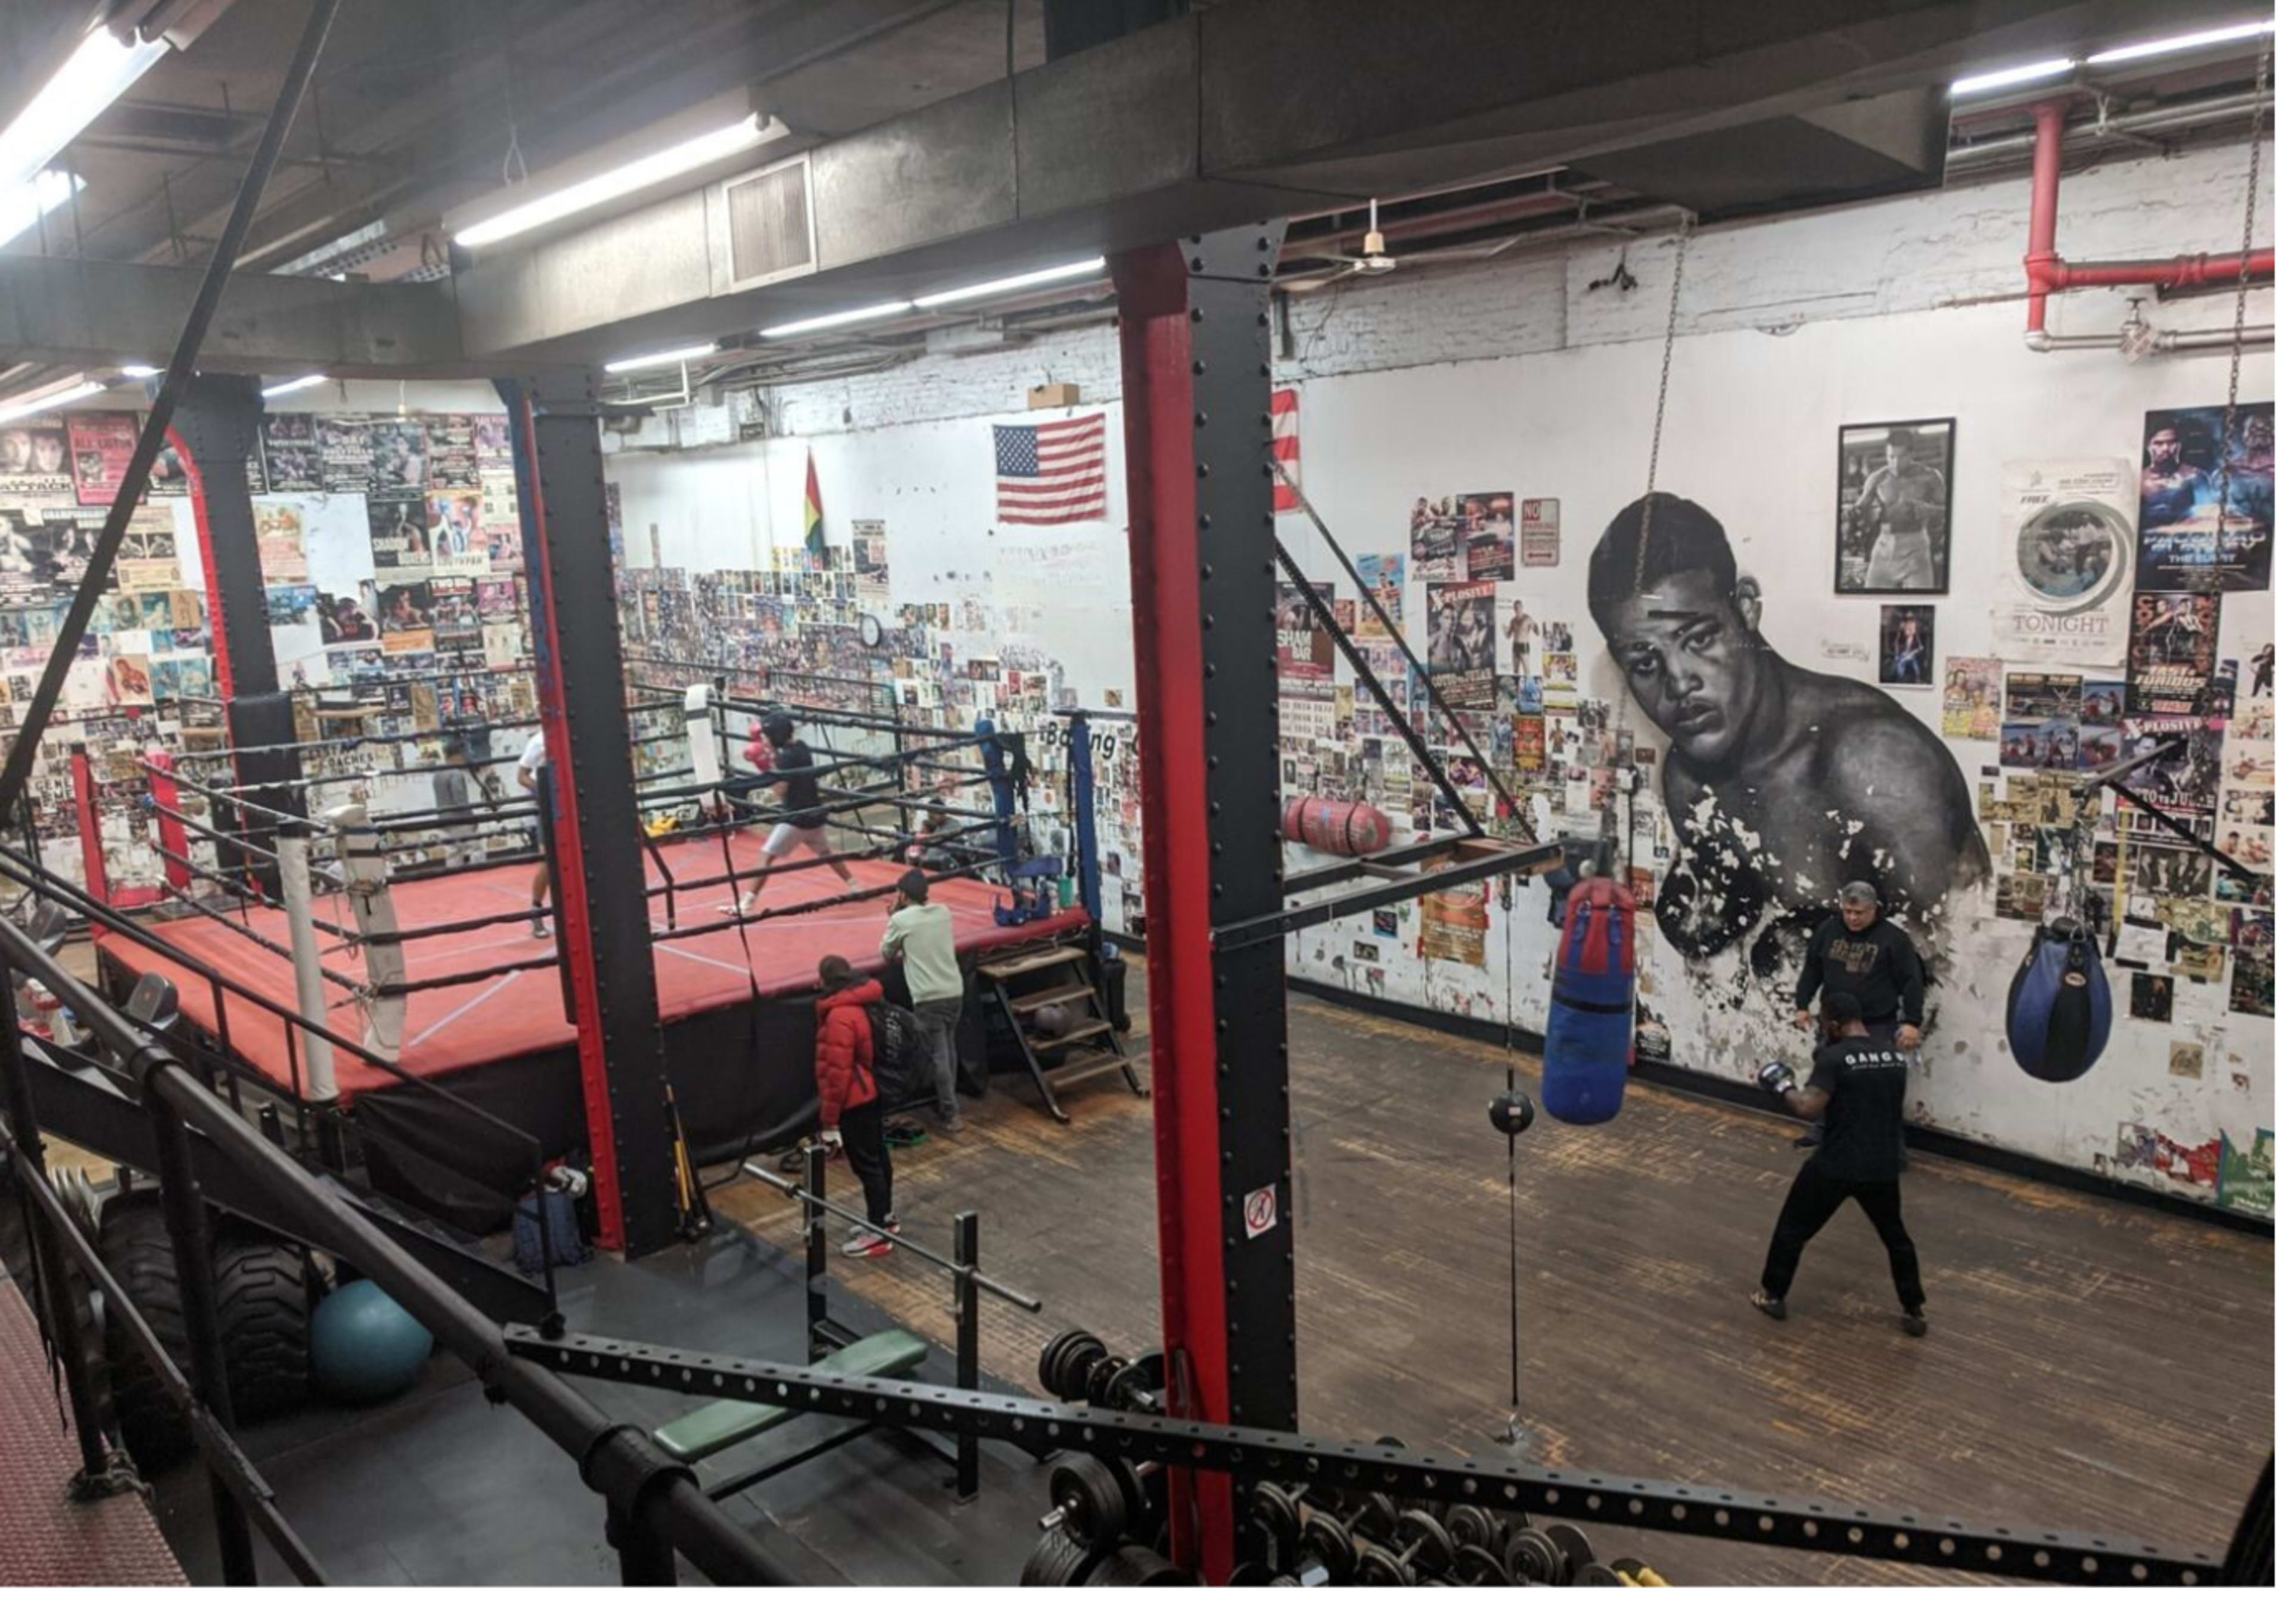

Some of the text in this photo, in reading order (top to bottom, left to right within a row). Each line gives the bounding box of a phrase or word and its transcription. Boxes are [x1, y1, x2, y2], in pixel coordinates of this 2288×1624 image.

[1525, 502, 1540, 519] NO
[2012, 615, 2110, 633] TONIGHT
[2135, 675, 2207, 686] FURIOUS
